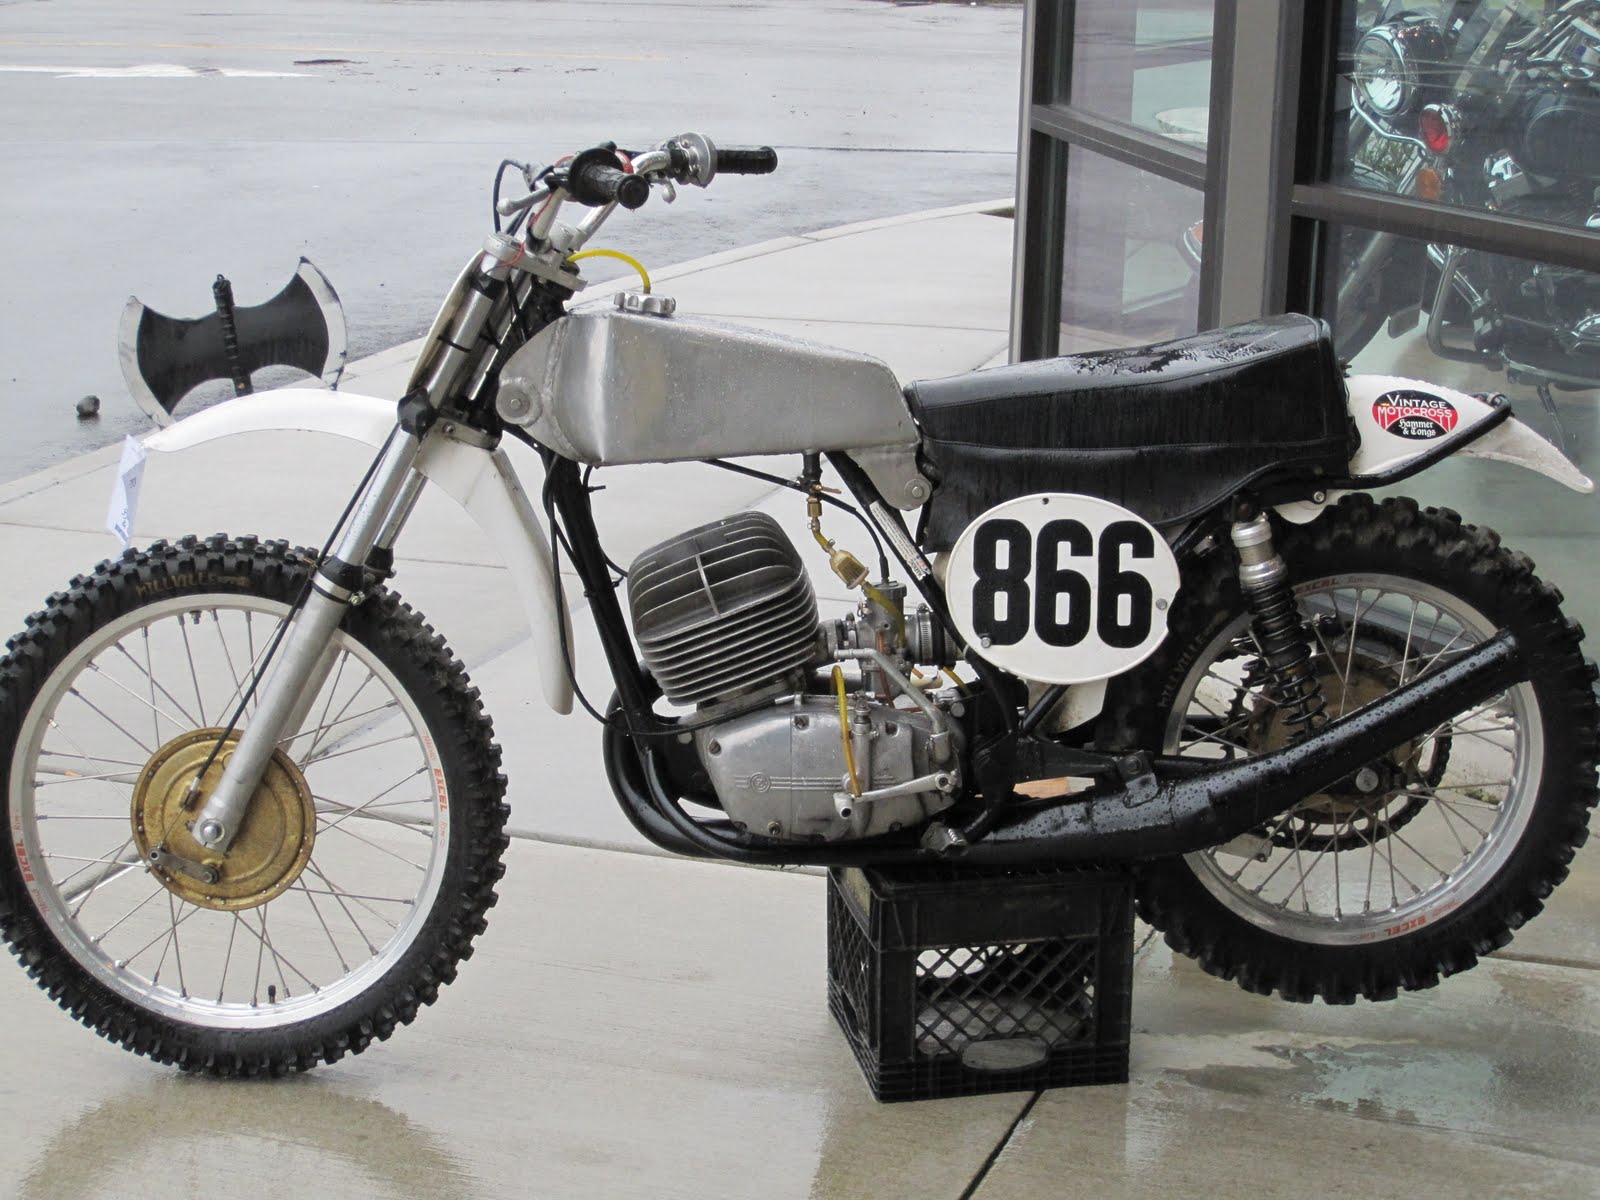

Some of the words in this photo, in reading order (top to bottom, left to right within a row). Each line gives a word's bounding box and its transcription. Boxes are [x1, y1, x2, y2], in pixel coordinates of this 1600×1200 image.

[1378, 406, 1452, 418] MOTOCROSS
[1399, 419, 1434, 428] Hammer
[1410, 428, 1436, 437] Tongs
[973, 518, 1154, 649] 866
[433, 768, 448, 811] EXCEL
[16, 840, 35, 882] EXCEL
[1384, 916, 1427, 935] EXCEL
